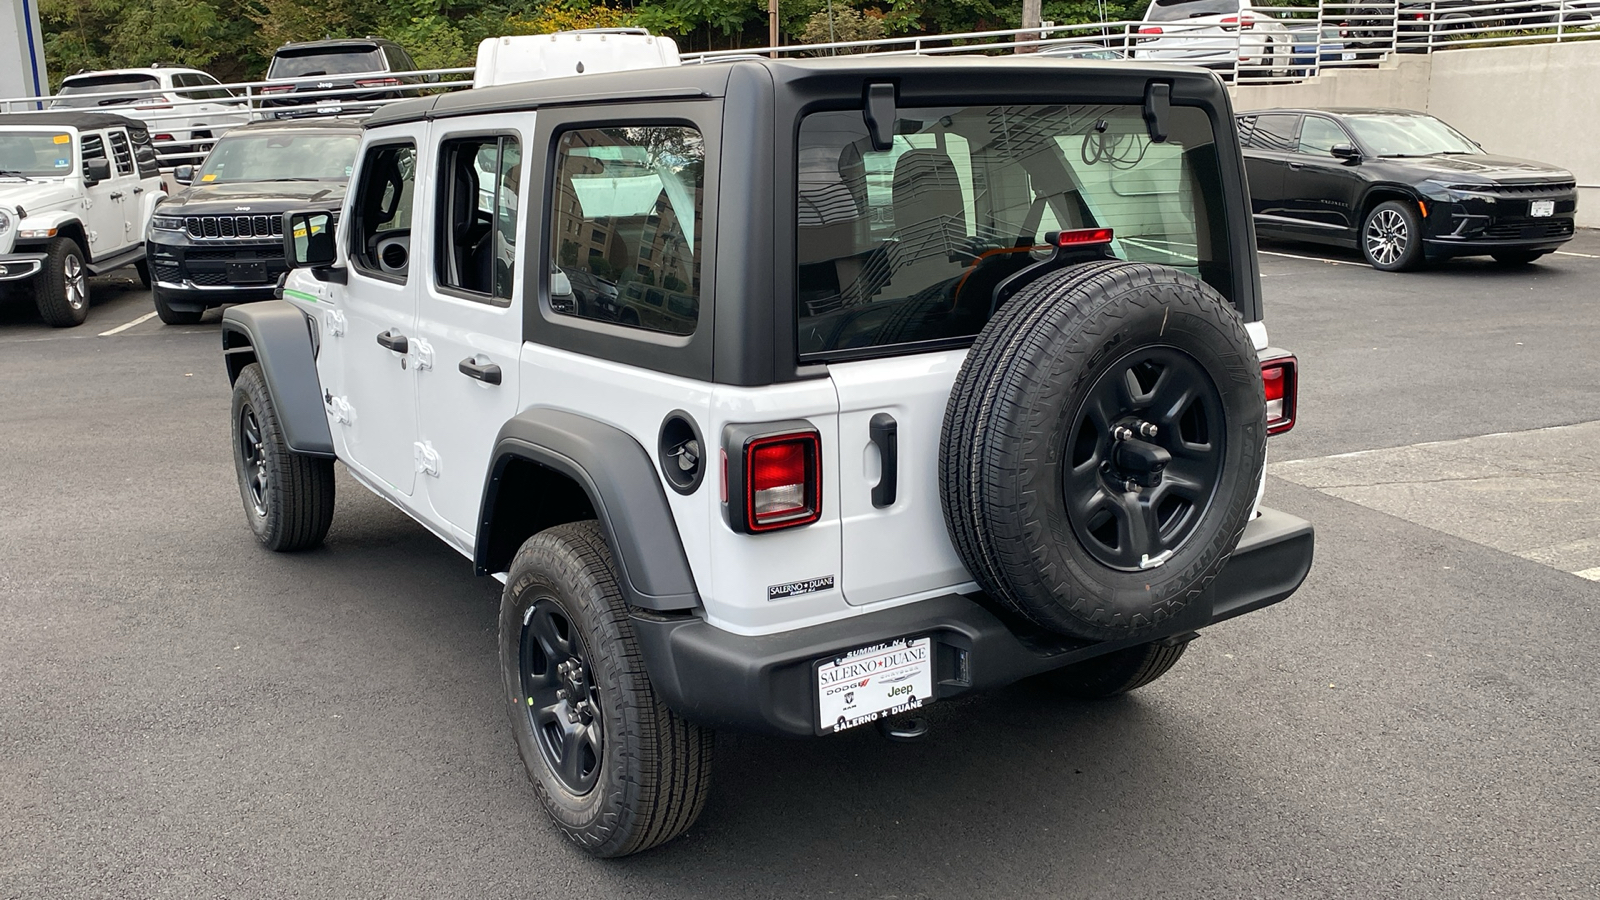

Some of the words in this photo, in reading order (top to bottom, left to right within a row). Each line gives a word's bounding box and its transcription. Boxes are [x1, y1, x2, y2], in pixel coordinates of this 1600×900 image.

[770, 583, 803, 595] SALERNO
[809, 577, 834, 588] DUANE
[820, 660, 877, 686] SALERNO
[883, 647, 926, 668] DUANE
[887, 684, 914, 698] Jeep
[833, 712, 878, 733] SALERNO
[891, 699, 923, 715] DUANE
